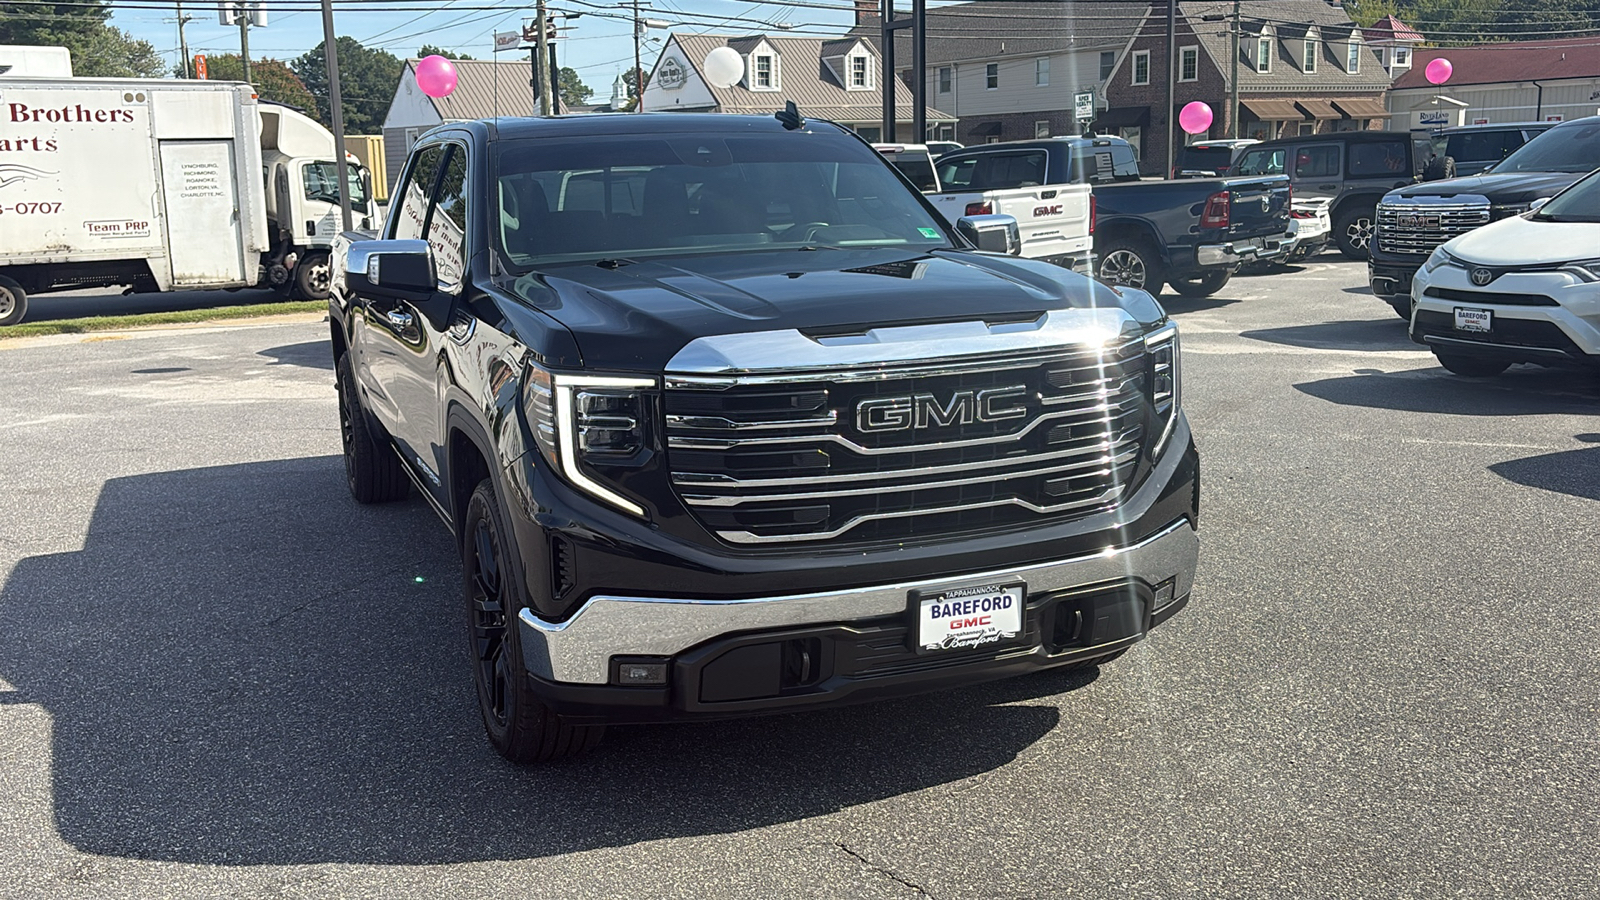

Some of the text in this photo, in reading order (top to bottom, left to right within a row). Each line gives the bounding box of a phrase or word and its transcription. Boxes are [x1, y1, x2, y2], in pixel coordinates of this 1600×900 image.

[8, 103, 134, 123] Brothers
[0, 136, 58, 152] arts
[0, 202, 62, 215] -0707
[1033, 204, 1063, 218] GMC
[87, 221, 148, 232] Team PRP
[1399, 216, 1439, 227] GMC
[1458, 311, 1488, 320] BAREFORD
[857, 384, 1027, 433] GMC
[945, 585, 1001, 599] TAPPAHANNOCK
[931, 595, 1012, 619] BAREFORD
[950, 615, 992, 630] GMC
[941, 630, 1002, 650] Bareford
